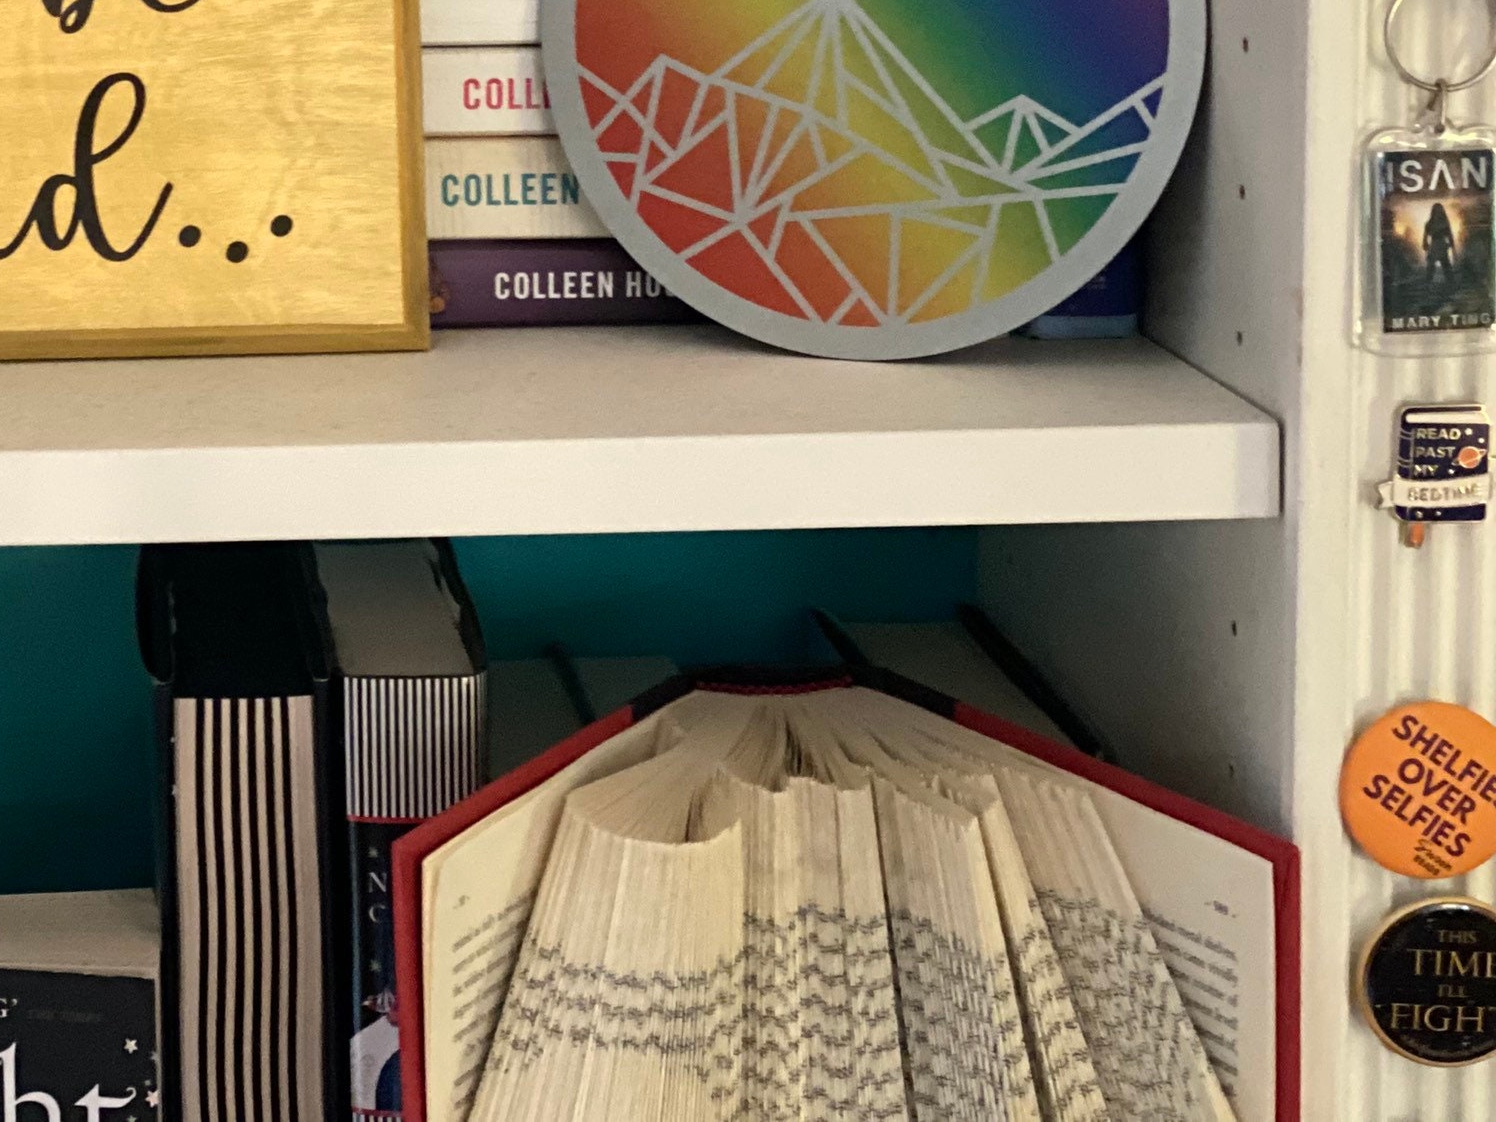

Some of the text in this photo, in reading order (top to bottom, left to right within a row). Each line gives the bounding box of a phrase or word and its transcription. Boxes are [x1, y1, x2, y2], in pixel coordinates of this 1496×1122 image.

[441, 173, 580, 207] COLLEEN
[493, 270, 614, 300] COLLEEN
[1391, 312, 1492, 330] MARY TING
[1416, 428, 1462, 440] READ
[1415, 446, 1457, 458] PAST
[1413, 464, 1439, 476] MY
[1407, 482, 1484, 502] BEDTIME
[1391, 714, 1496, 809] SHELFIE
[1397, 757, 1477, 826] OVER
[1362, 774, 1472, 859] SELFIES
